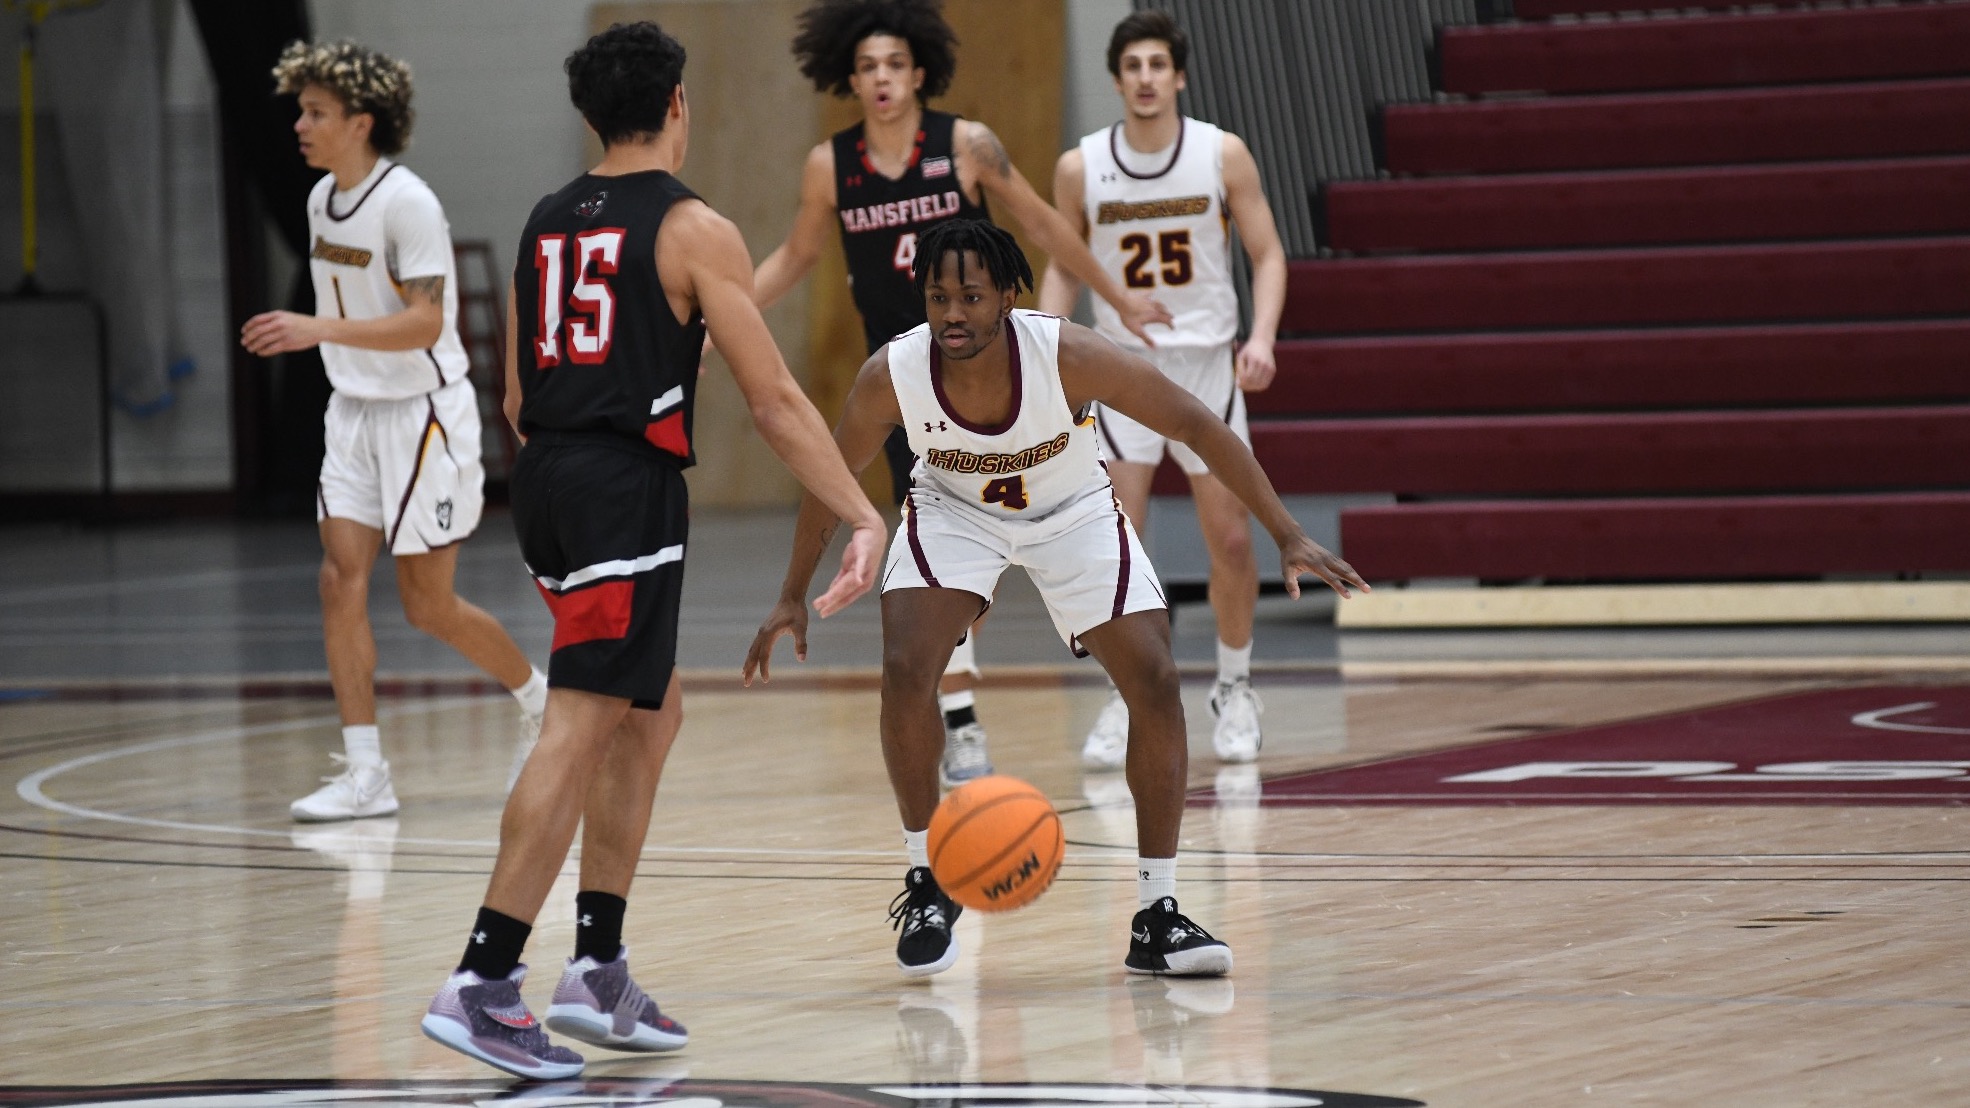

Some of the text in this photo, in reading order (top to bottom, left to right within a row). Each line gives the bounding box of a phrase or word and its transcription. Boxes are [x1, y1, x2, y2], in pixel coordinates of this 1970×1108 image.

[840, 191, 961, 233] MANSFIELD
[1120, 228, 1194, 289] 25
[533, 227, 627, 369] 15
[927, 432, 1070, 474] HUSKIES
[980, 474, 1030, 512] 4
